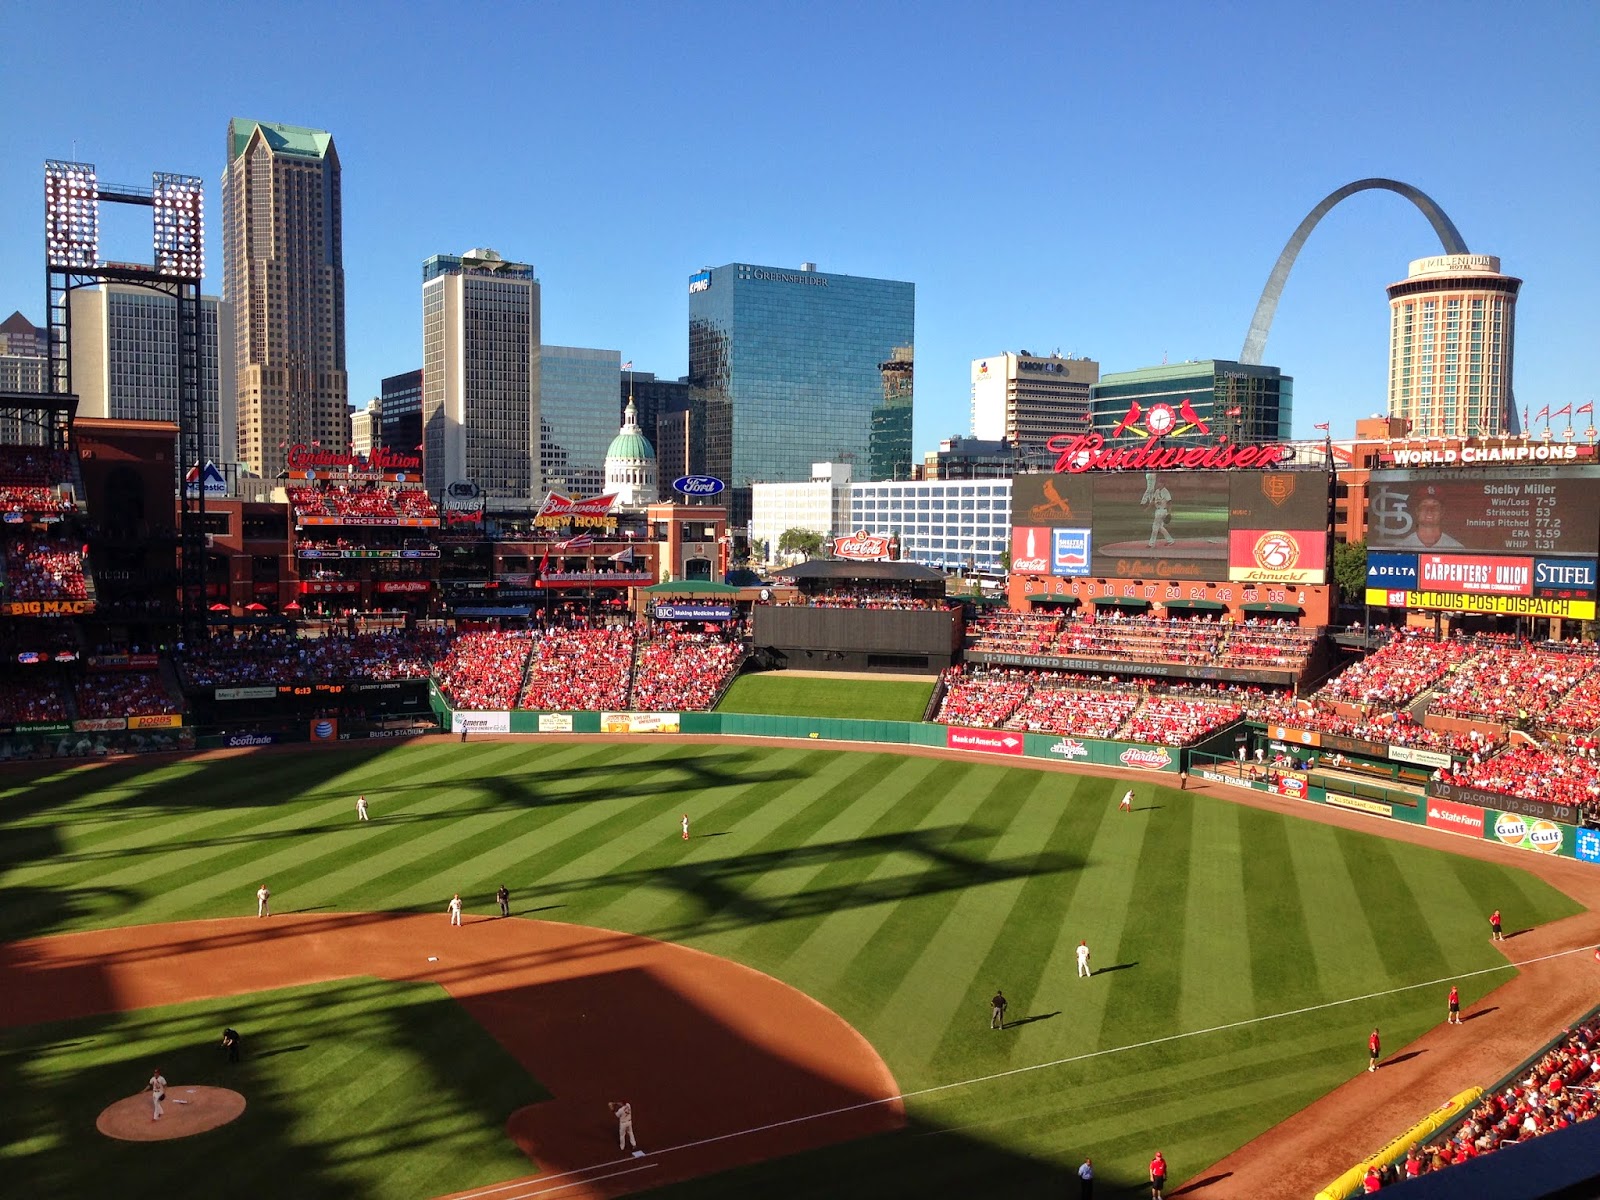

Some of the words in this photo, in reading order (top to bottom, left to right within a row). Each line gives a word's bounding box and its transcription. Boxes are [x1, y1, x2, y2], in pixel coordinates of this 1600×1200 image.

[1427, 256, 1490, 268] MILLENNIUM
[689, 279, 708, 294] KPMG
[1018, 361, 1044, 372] KMOV
[1224, 371, 1248, 380] Deloitte
[288, 444, 360, 469] Cardinals
[360, 447, 420, 471] Nation
[1046, 433, 1292, 473] Budweiser
[1393, 449, 1456, 464] WORLD
[1461, 445, 1577, 463] CHAMPIONS
[348, 472, 384, 481] ROOFTOP
[186, 483, 225, 492] Maestic
[683, 477, 715, 492] Ford
[1484, 484, 1520, 496] Shelby
[1524, 484, 1556, 494] Miller
[443, 501, 485, 510] MIDWEST
[1491, 498, 1530, 506] Win/Loss
[1536, 497, 1556, 506] 7-5
[1486, 508, 1530, 516] Strikeouts
[1536, 508, 1551, 517] 53
[535, 516, 572, 527] BREW
[575, 517, 619, 528] HOUSE
[1466, 519, 1495, 527] Innings
[1498, 519, 1529, 527] Pitched
[1535, 519, 1561, 527] 77.2
[1512, 530, 1530, 538] ERA
[1535, 529, 1561, 538] 3.59
[840, 539, 882, 555] Coca-Cola
[1505, 540, 1528, 548] WHIP
[1534, 540, 1554, 549] 1.31
[1263, 542, 1289, 565] 75
[1013, 558, 1048, 571] Coca-Cola
[1157, 560, 1201, 576] Cardinals
[1380, 567, 1416, 577] DELTA
[1424, 563, 1492, 584] CARPENTERS'
[1496, 565, 1528, 585] UNION
[1536, 563, 1594, 585] STIFEL
[1043, 582, 1049, 593] 1
[1056, 583, 1063, 594] 2
[1072, 583, 1079, 594] 6
[1087, 584, 1095, 595] 9
[1103, 584, 1114, 596] 10
[1124, 584, 1135, 597] 14
[1145, 585, 1156, 598] 17
[1166, 587, 1181, 599] 20
[1190, 588, 1206, 600] 24
[1217, 589, 1232, 601] 42
[1242, 589, 1258, 602] 45
[1269, 590, 1285, 603] 85
[11, 601, 41, 615] BIG
[44, 601, 85, 614] MAC
[1409, 591, 1426, 607] ST.
[1429, 593, 1464, 608] LOUIS
[1468, 595, 1570, 615] POST-DISPATCH
[658, 608, 673, 617] BJC
[983, 653, 1021, 663] 11-TIME
[1062, 659, 1099, 669] SERIES
[1102, 663, 1168, 675] CHAMPIONS
[294, 686, 312, 695] 6:13
[139, 716, 172, 725] DOBBS
[370, 730, 393, 738] BUSCH
[395, 728, 424, 736] STADIUM
[230, 734, 272, 746] Scottrade
[968, 736, 976, 744] of
[975, 737, 1002, 748] America
[1391, 750, 1409, 759] Mercy
[1203, 771, 1224, 782] BUSCH
[1224, 776, 1252, 788] STADIUM
[1279, 769, 1307, 780] STLFORD
[1285, 789, 1301, 798] .COM
[1435, 783, 1451, 795] yp
[1458, 790, 1497, 805] yp.com
[1506, 798, 1519, 810] yp
[1522, 801, 1545, 815] app
[1553, 805, 1570, 818] yp
[1497, 824, 1525, 834] Gulf
[1530, 832, 1559, 842] Gulf
